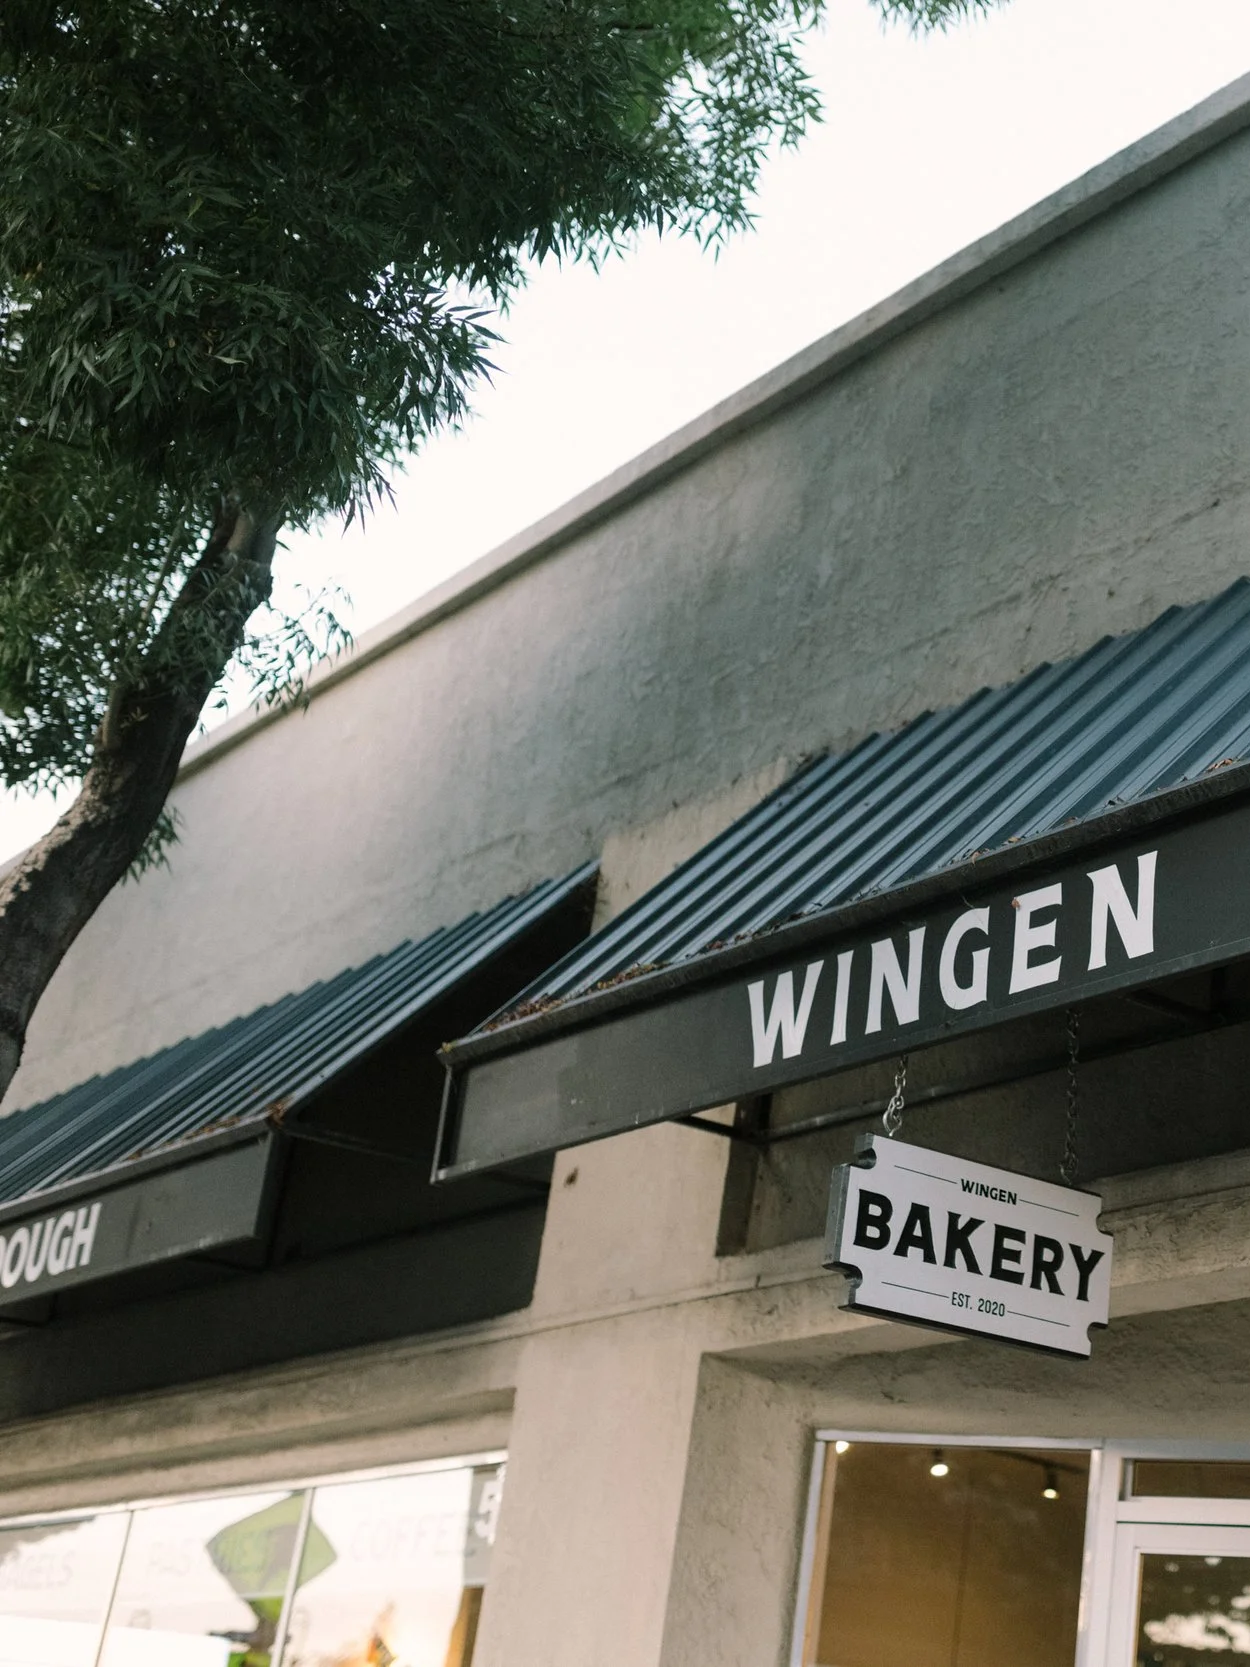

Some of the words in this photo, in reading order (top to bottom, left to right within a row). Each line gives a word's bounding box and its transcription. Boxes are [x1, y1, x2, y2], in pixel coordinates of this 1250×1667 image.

[747, 850, 1158, 1068] WINGEN
[960, 1178, 1018, 1206] WINGEN
[0, 1201, 102, 1289] OUGH
[853, 1188, 1105, 1302] BAKERY
[951, 1291, 973, 1311] EST.
[977, 1297, 1006, 1317] 2020
